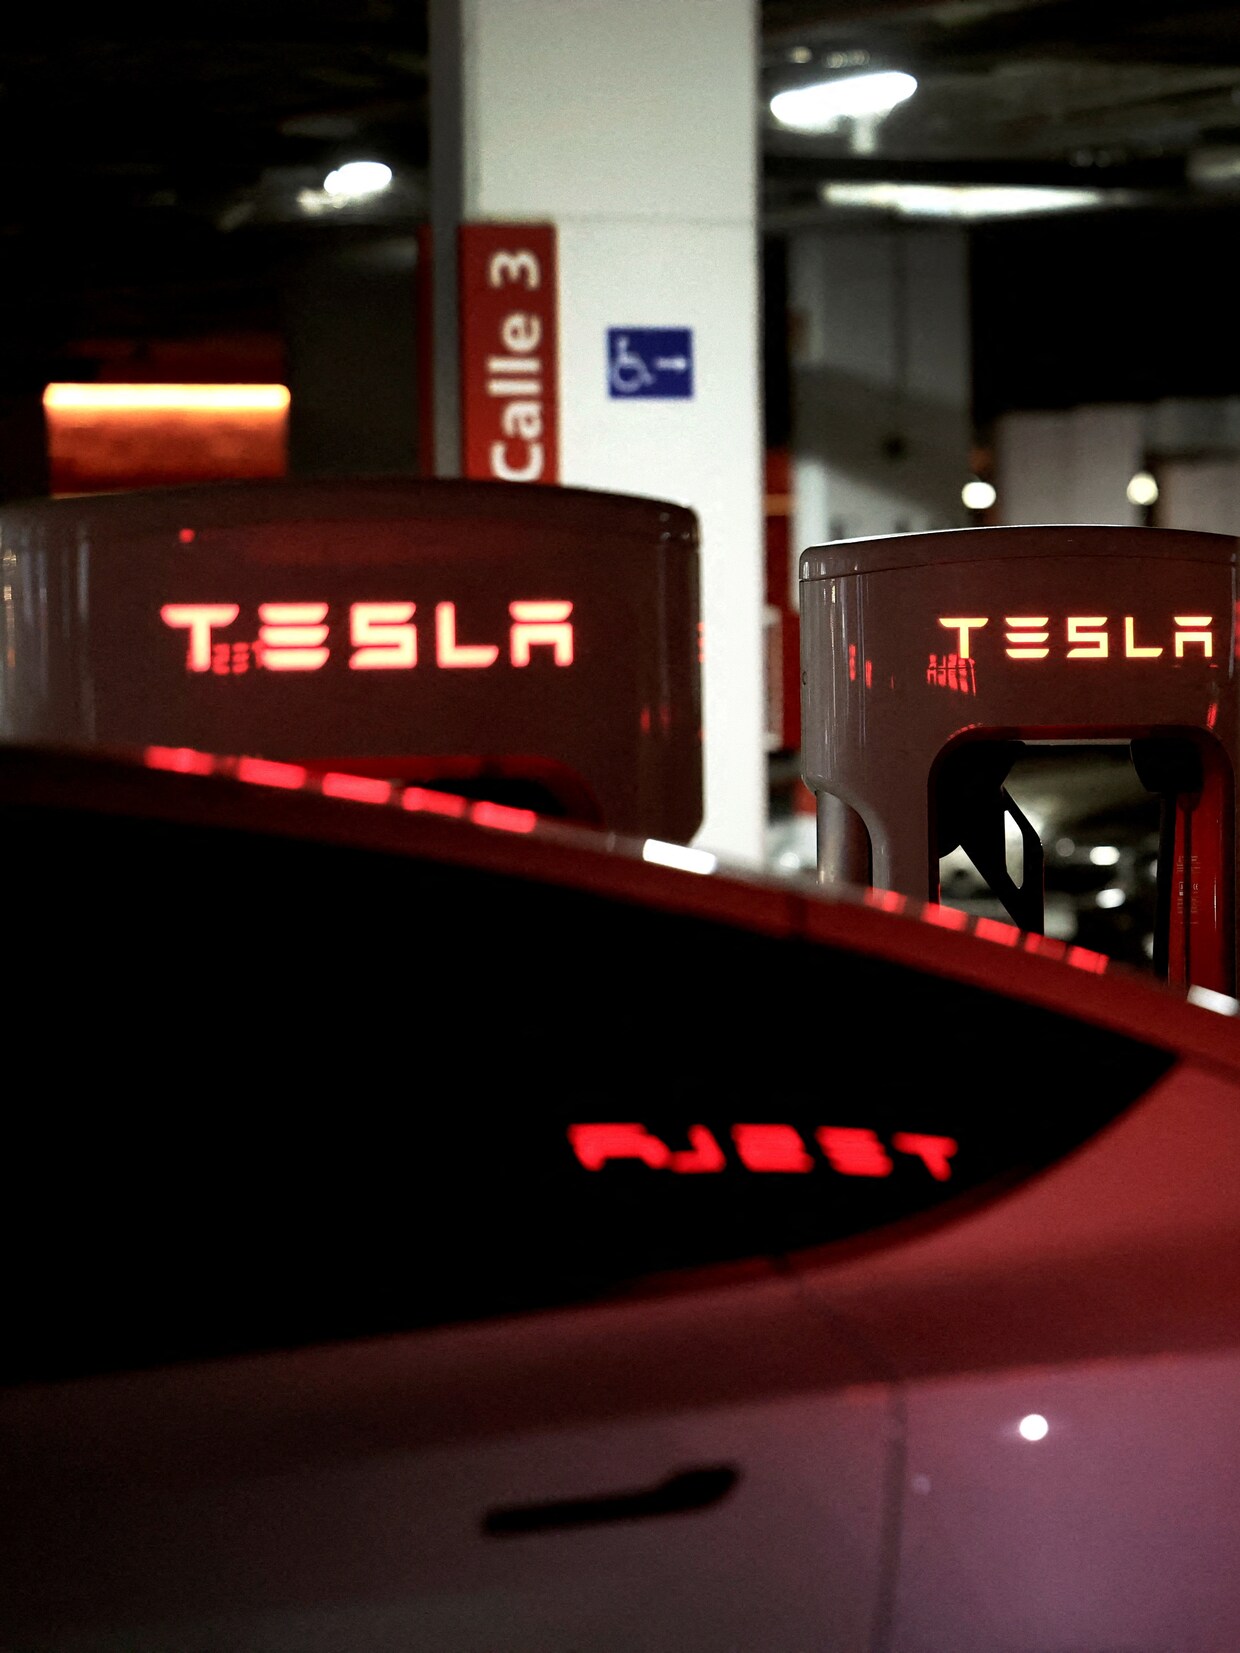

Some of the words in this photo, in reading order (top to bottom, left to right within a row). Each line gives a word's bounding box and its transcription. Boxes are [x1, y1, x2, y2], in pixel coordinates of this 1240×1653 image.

[488, 249, 541, 290] 3
[487, 311, 544, 483] Calle
[159, 600, 574, 673] TESLA
[938, 616, 1213, 659] TESLA
